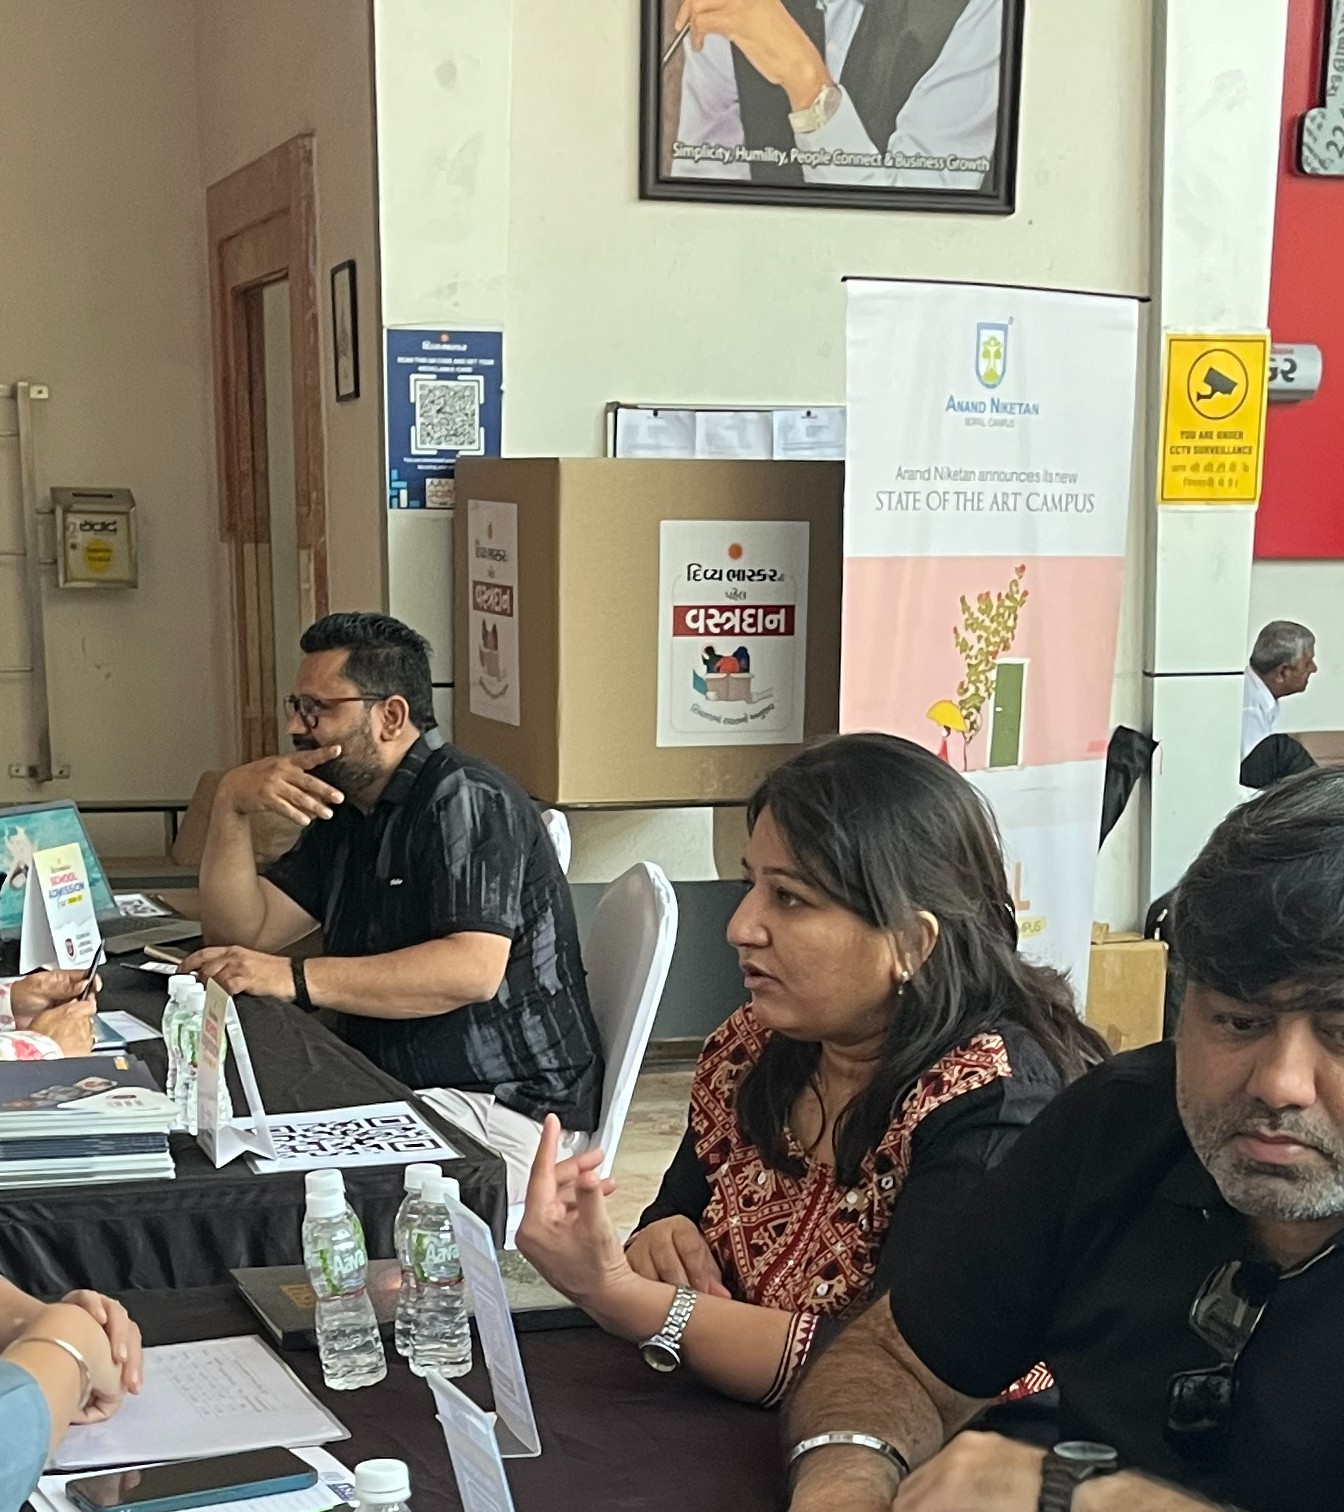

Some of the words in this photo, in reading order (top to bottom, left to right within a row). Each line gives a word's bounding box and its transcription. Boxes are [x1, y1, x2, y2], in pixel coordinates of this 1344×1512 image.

[672, 142, 733, 164] Simplicity,
[790, 148, 831, 167] People
[833, 152, 882, 168] Connect
[884, 153, 894, 168] &
[895, 153, 945, 170] Business
[946, 155, 990, 172] Growth
[1180, 431, 1197, 439] YOU
[1199, 431, 1213, 440] ARE
[1216, 431, 1243, 440] UNDER
[1170, 446, 1191, 454] CCTV
[1193, 446, 1253, 455] SURVEILLANCE
[895, 466, 931, 481] Anand
[934, 466, 976, 481] Niketan
[978, 470, 1040, 483] announces
[875, 491, 921, 511] STATE
[926, 491, 949, 511] OF
[954, 491, 984, 511] THE
[989, 492, 1022, 512] ART
[1025, 492, 1095, 513] CAMPUS
[686, 562, 723, 582] દિવ્ય
[726, 567, 778, 583] ભાસ્કર
[686, 608, 785, 634] વસ્ત્રદાન
